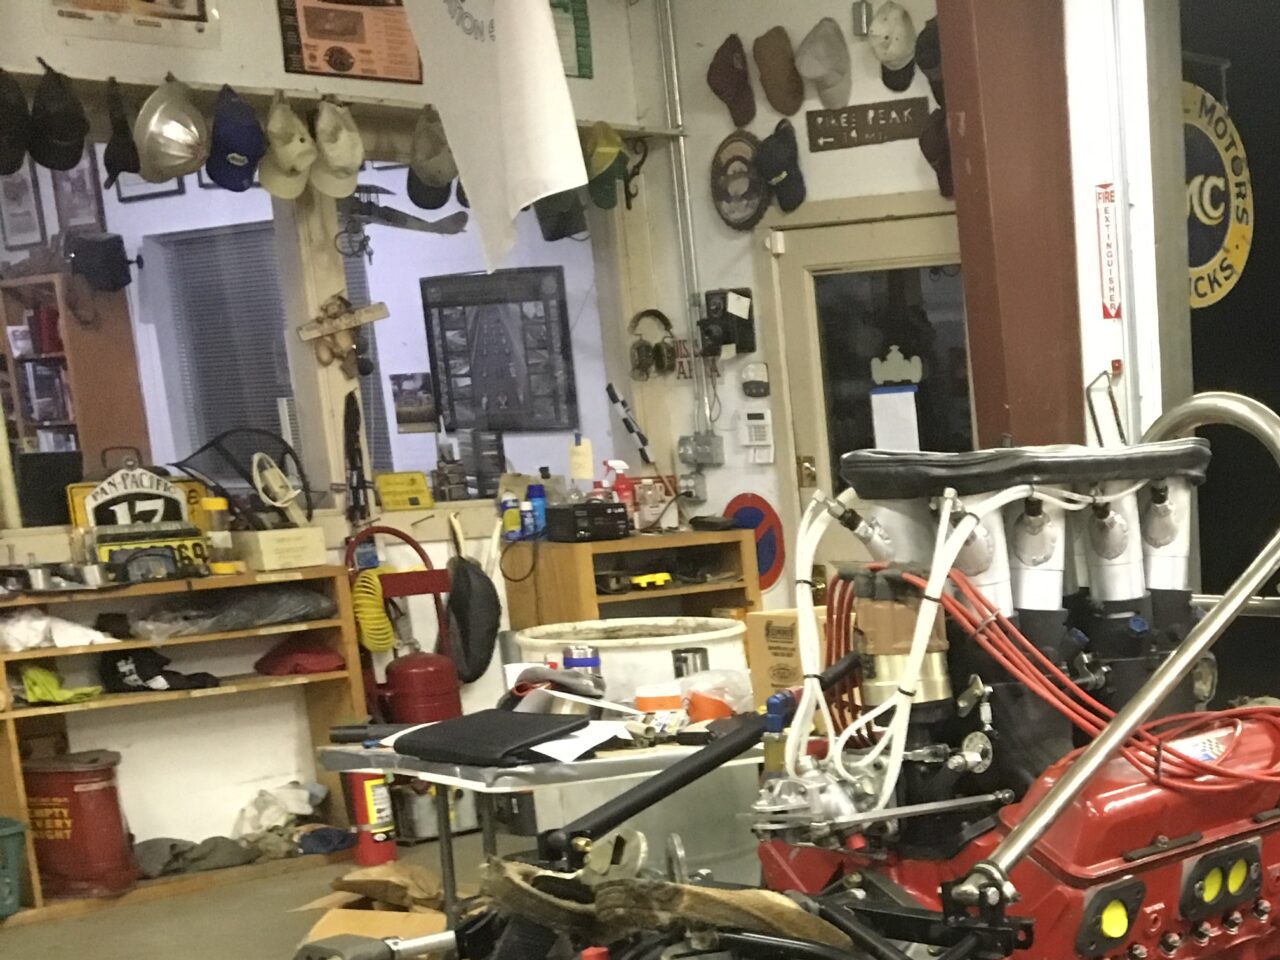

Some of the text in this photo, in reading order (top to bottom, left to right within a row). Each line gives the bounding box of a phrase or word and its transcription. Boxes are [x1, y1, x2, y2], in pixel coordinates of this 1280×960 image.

[867, 107, 913, 125] PEAK
[1199, 94, 1249, 226] MOTORS
[1097, 189, 1115, 203] FIRE
[1103, 205, 1117, 311] EXTINGUISHER
[109, 498, 165, 525] 17
